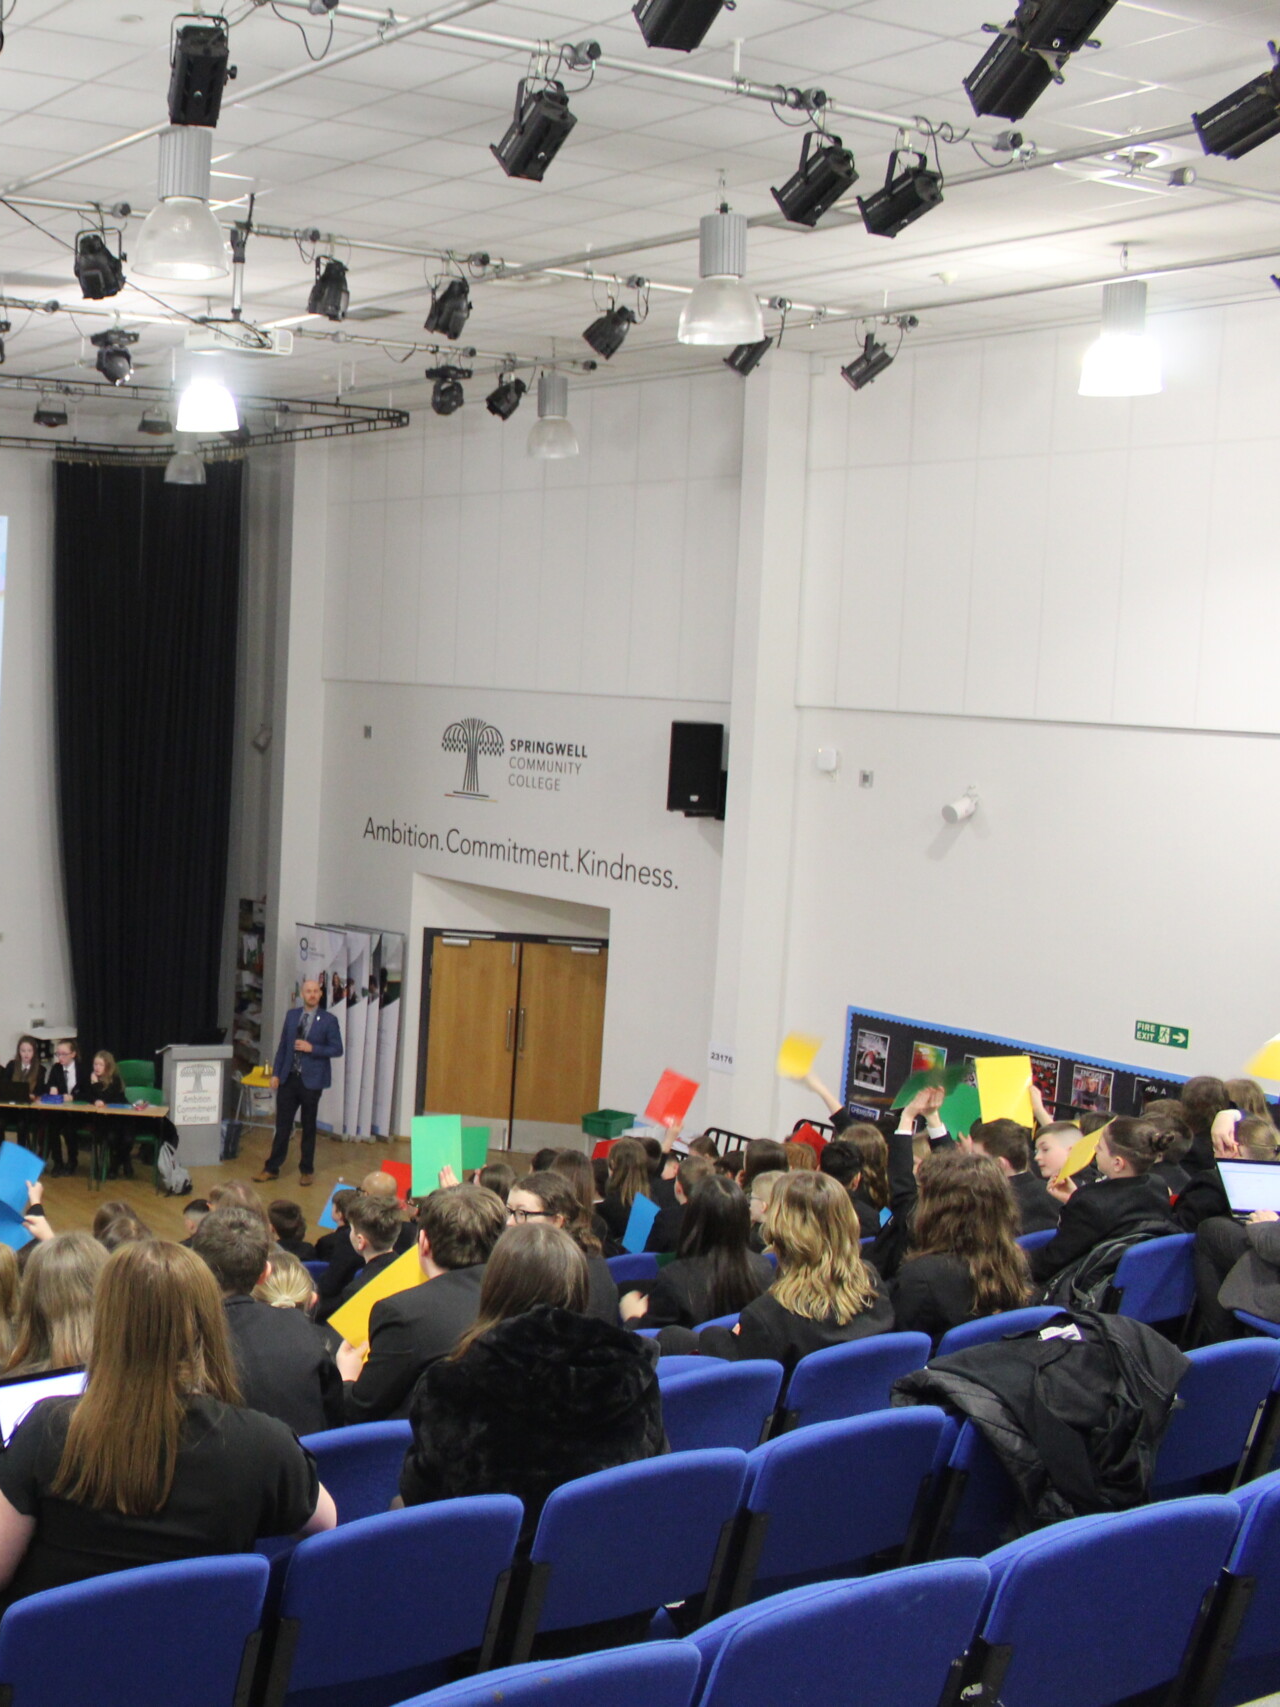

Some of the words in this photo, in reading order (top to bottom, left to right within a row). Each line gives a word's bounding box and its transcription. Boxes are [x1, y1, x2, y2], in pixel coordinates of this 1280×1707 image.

[510, 738, 588, 758] SPRINGWELL
[509, 756, 582, 775] COMMUNITY
[508, 773, 561, 791] COLLEGE
[363, 816, 444, 851] Ambition.
[445, 828, 574, 873] Commitment.
[577, 848, 679, 890] Kindness.
[1137, 1023, 1156, 1033] FIRE
[1136, 1031, 1155, 1041] EXIT
[711, 1051, 733, 1065] 23176
[183, 1095, 211, 1103] Ambition
[176, 1104, 217, 1114] Commitment
[182, 1114, 210, 1122] Kindness
